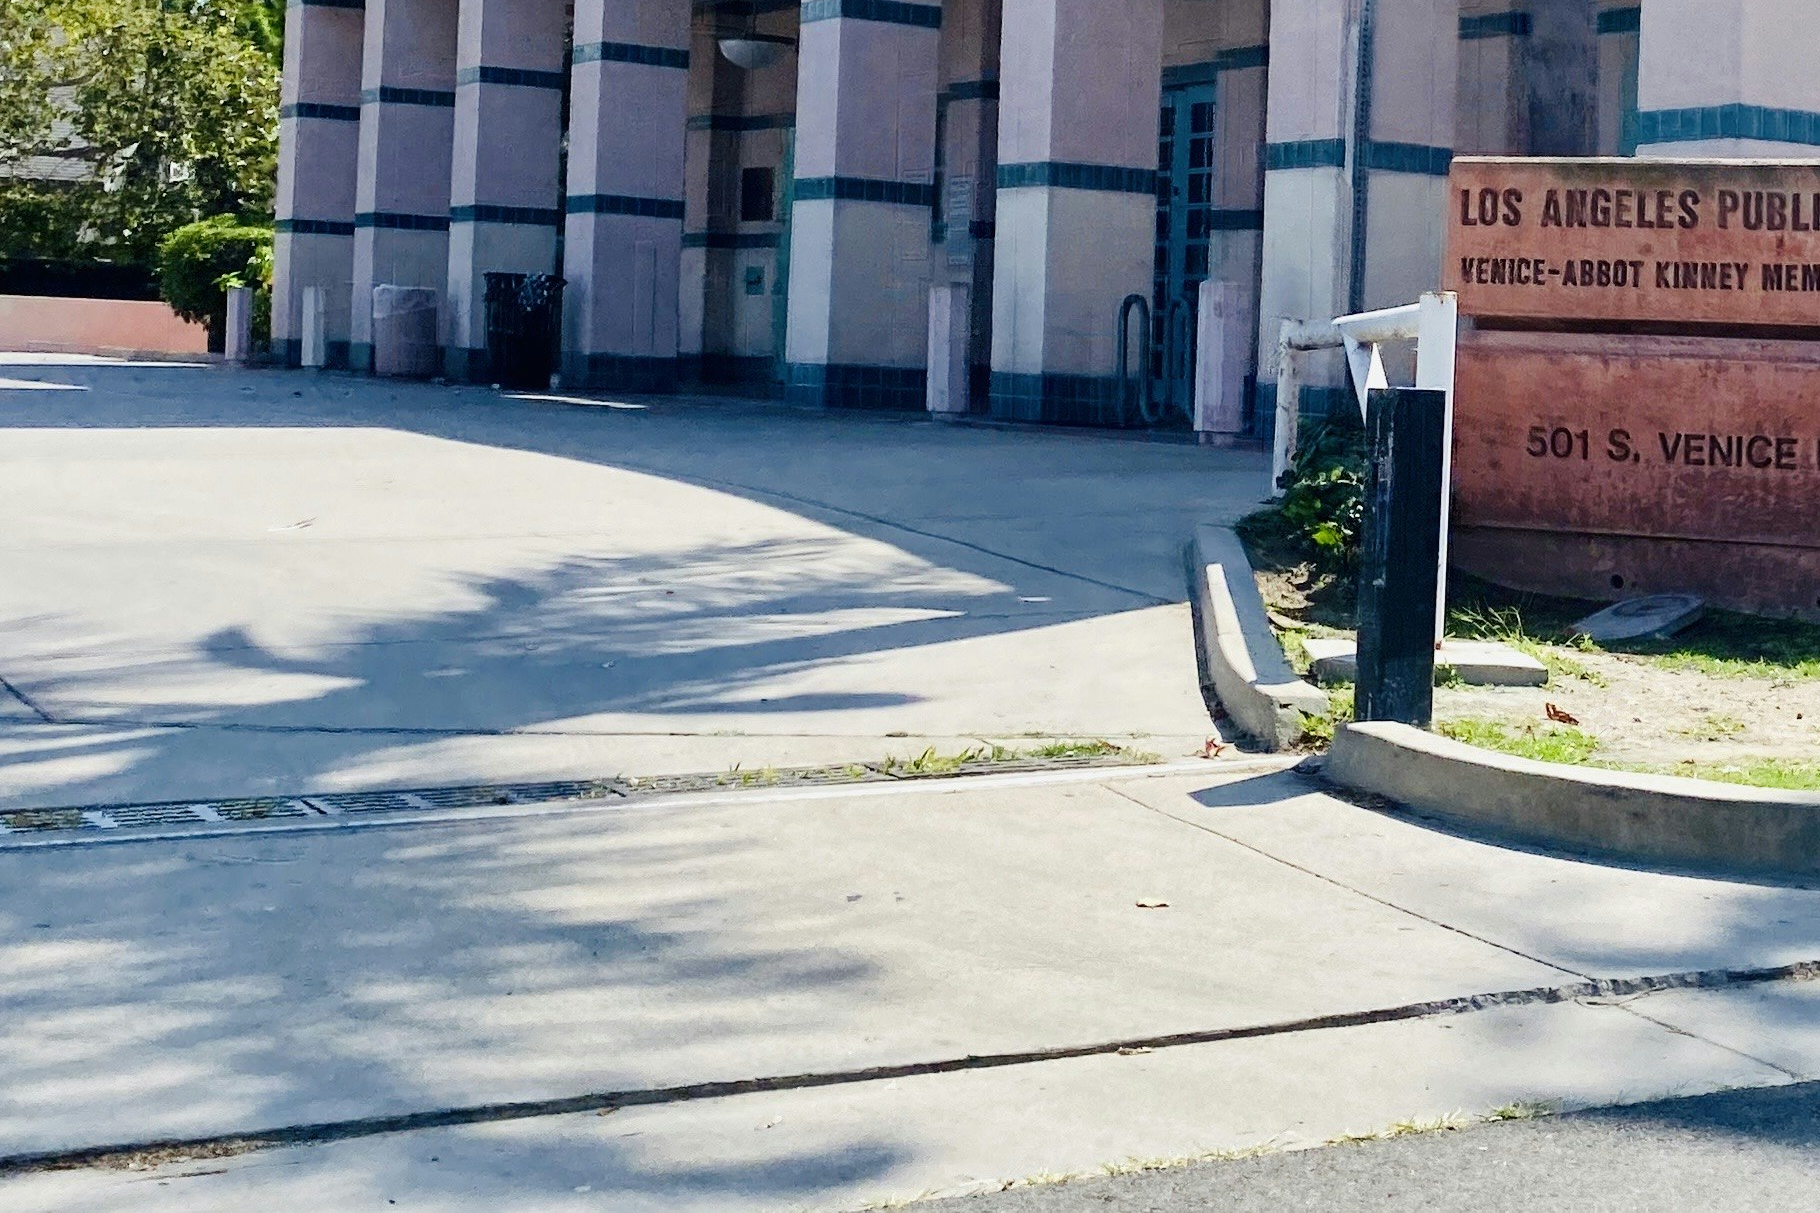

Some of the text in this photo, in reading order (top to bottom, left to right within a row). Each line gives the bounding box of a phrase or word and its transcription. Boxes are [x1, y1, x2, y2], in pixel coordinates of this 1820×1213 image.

[1460, 187, 1522, 227] LOS
[1540, 188, 1700, 229] ANGELES
[1460, 257, 1644, 288] VENICE-ABBOT
[1654, 261, 1749, 290] KINNEY
[1526, 426, 1589, 461] 501
[1606, 428, 1640, 463] S.
[1658, 432, 1798, 471] VENICE
